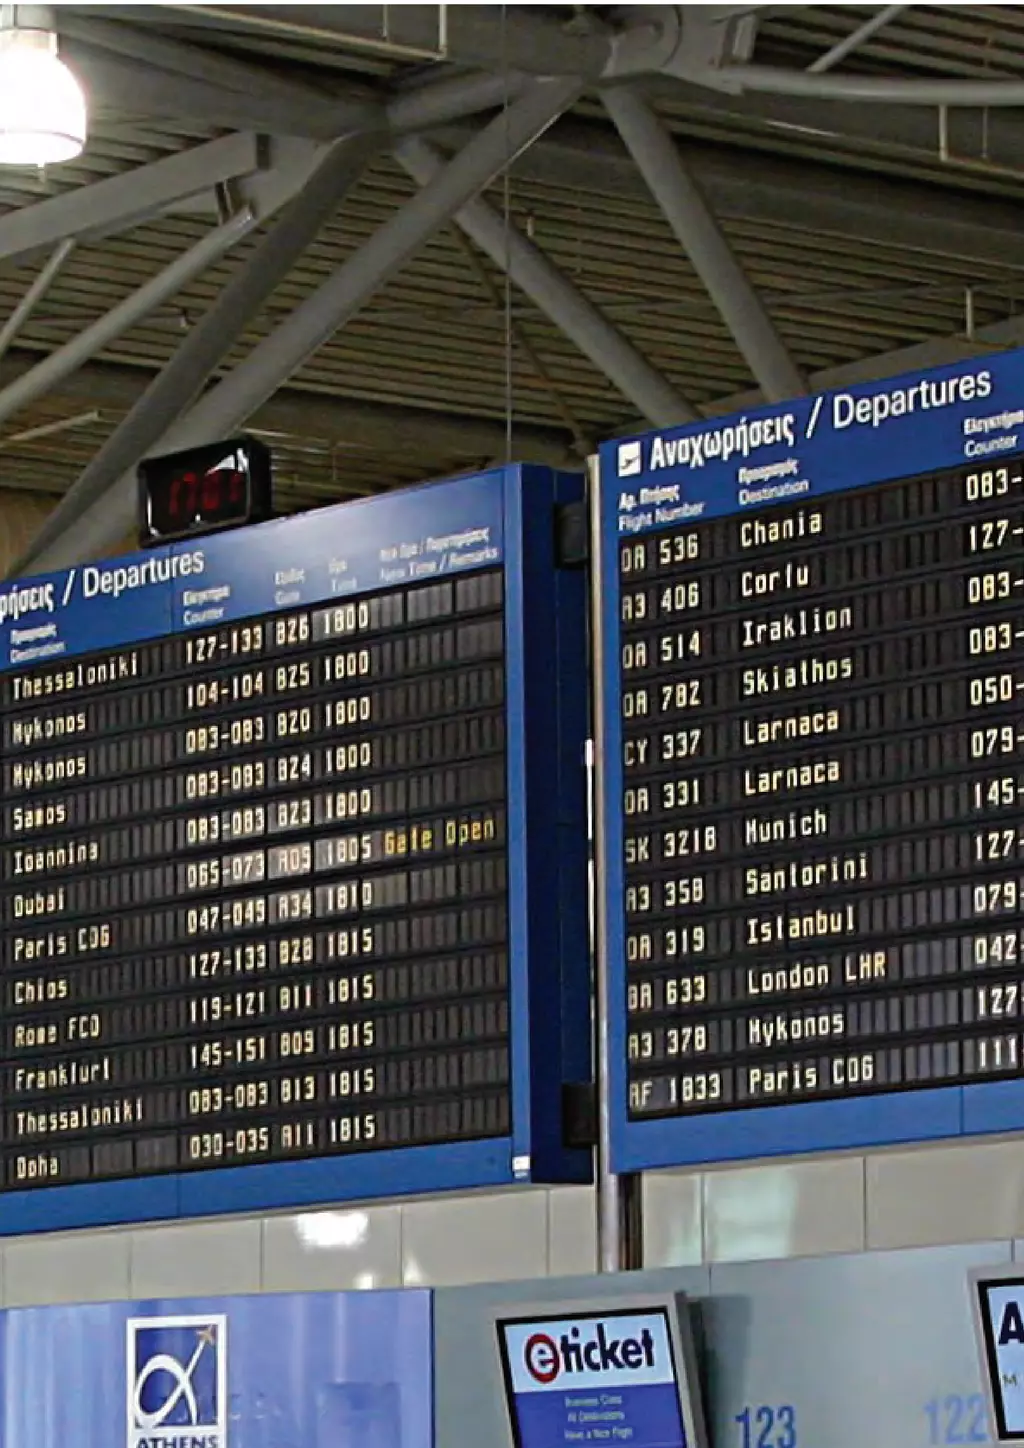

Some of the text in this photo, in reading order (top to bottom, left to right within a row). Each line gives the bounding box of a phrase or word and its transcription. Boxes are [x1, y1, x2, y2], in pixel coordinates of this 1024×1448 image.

[833, 370, 991, 430] Departures
[660, 533, 698, 565] 536
[741, 513, 822, 548] Chania
[83, 551, 205, 598] Departures
[660, 582, 699, 612] 406
[13, 602, 369, 699] Thessaloniki 127-133 1800
[661, 630, 700, 662] 514
[743, 607, 851, 646] Iraklion
[187, 671, 263, 708] 104-104
[325, 649, 369, 681] 1800
[662, 680, 700, 711] 782
[185, 716, 264, 754] 083-083
[325, 696, 370, 727] 1800
[624, 739, 648, 767] CY
[662, 728, 701, 760] 337
[744, 710, 839, 746] Larnaca
[186, 761, 265, 799] 083-083
[325, 742, 371, 773] 1800
[663, 779, 699, 808] 331
[745, 761, 840, 796] Larnaca
[14, 789, 371, 874] Ioannina 083-083 1800
[187, 849, 265, 889] 065-073
[327, 834, 372, 867] 1805
[445, 819, 494, 847] Open
[625, 836, 649, 863] SK
[664, 825, 717, 857] 3218
[746, 808, 826, 845] Munich
[665, 877, 703, 907] 358
[14, 934, 67, 962] Paris
[327, 882, 372, 912] 1810
[665, 926, 705, 956] 319
[15, 927, 372, 1005] Chios 127-133 1815
[666, 975, 705, 1005] 633
[748, 963, 829, 995] London
[845, 951, 886, 982] LHR
[191, 991, 265, 1023] 119-121
[328, 974, 373, 1005] 1815
[191, 1037, 265, 1069] 145-151
[329, 1020, 374, 1050] 1815
[667, 1025, 706, 1055] 378
[748, 1013, 843, 1047] Mykonos
[18, 1068, 374, 1134] Thessaloniki 083-083 1815
[670, 1072, 721, 1104] 1033
[749, 1063, 817, 1094] Paris
[189, 1127, 269, 1159] 030-035
[330, 1114, 375, 1143] 1815
[924, 1394, 988, 1444] 122
